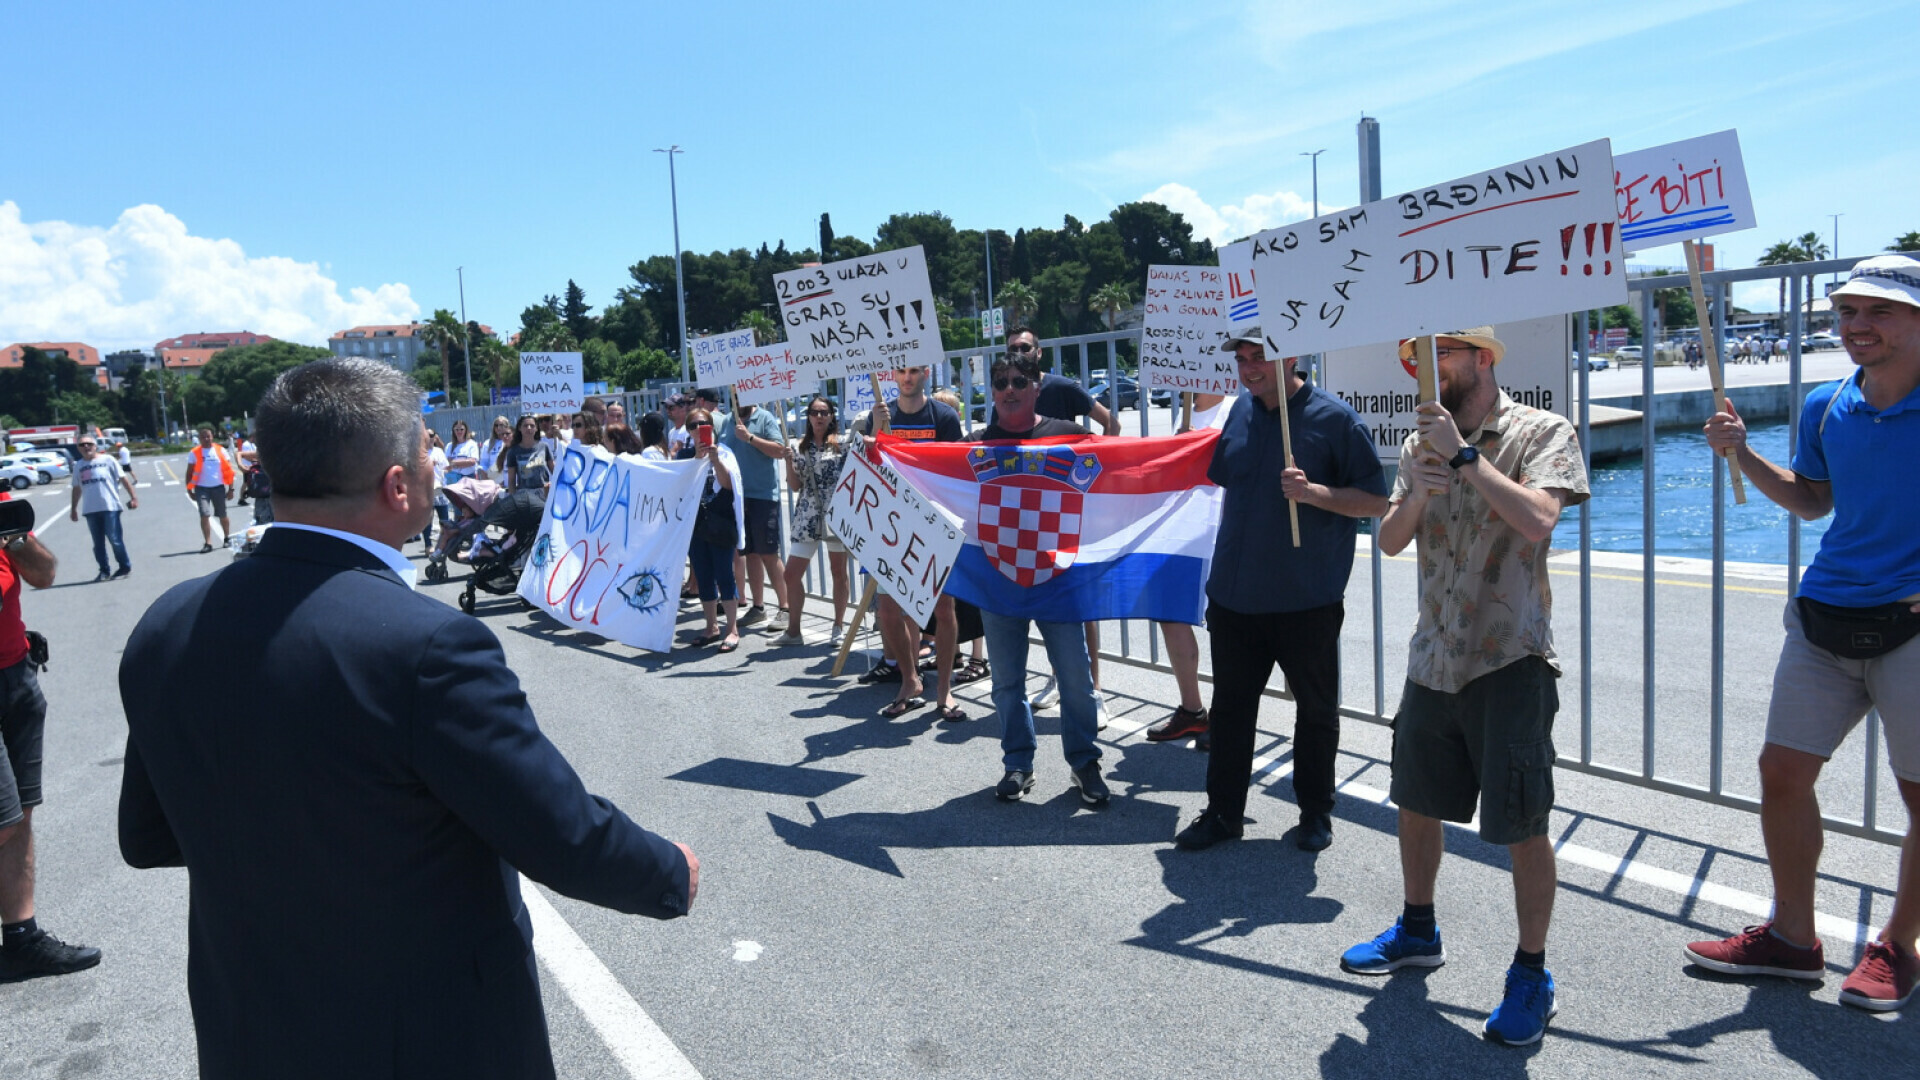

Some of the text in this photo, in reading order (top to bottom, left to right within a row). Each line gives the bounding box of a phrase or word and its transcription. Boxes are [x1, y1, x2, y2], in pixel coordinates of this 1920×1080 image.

[1650, 158, 1724, 214] BITI
[1252, 154, 1579, 261] AKO SAM BRĐANIN
[1399, 239, 1541, 285] DITE
[777, 279, 793, 299] 2
[837, 261, 888, 281] ULAZA
[897, 257, 907, 269] U
[1149, 269, 1190, 283] DANAS
[1147, 288, 1225, 301] PUT ZALIVATE
[1280, 299, 1308, 331] JA
[1319, 248, 1372, 329] SAM
[786, 290, 890, 326] GRAD SU
[1146, 304, 1169, 314] OVA
[810, 319, 874, 350] NAŠA
[1215, 331, 1231, 340] TA
[1142, 342, 1216, 356] PRIČA NE
[521, 355, 553, 365] VAMA
[796, 352, 842, 366] GRADSKI
[1142, 356, 1233, 375] PROLAZI NA
[537, 364, 575, 375] PARE
[817, 369, 829, 379] LI
[845, 361, 884, 374] MIRNO
[523, 382, 572, 394] NAMA
[737, 372, 766, 393] HOĆE
[523, 399, 580, 411] DOKTORI
[551, 447, 631, 551] BRDA
[836, 469, 950, 598] ARSEN
[943, 524, 956, 540] TO
[840, 519, 866, 553] NIJE
[877, 557, 930, 616] DEDIĆ
[546, 538, 624, 626] OČI
